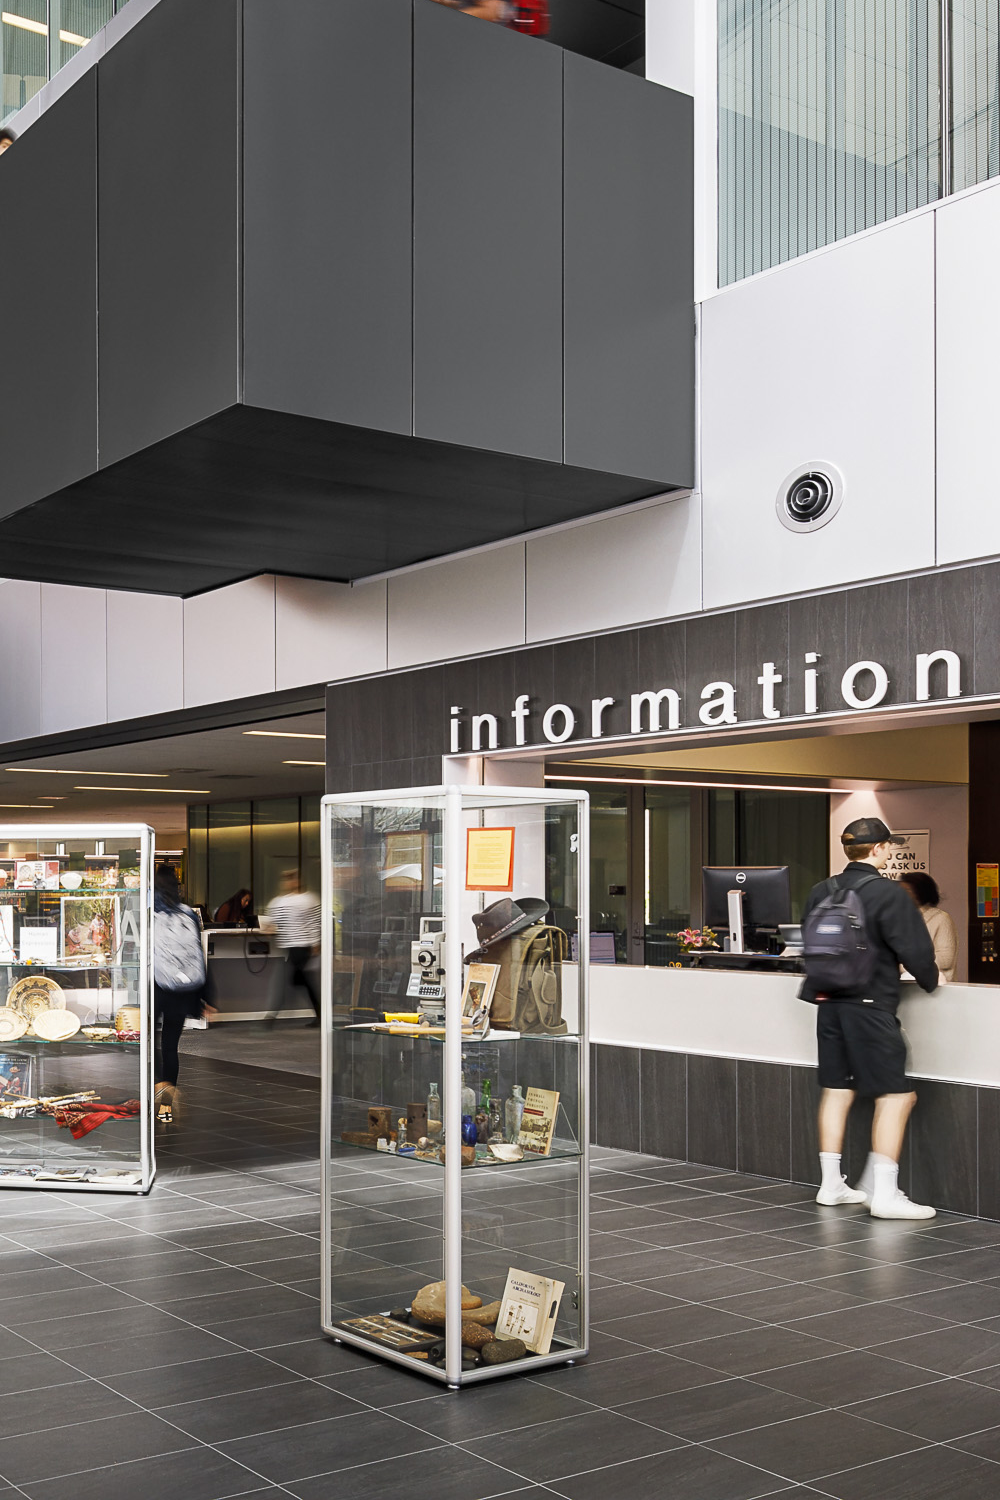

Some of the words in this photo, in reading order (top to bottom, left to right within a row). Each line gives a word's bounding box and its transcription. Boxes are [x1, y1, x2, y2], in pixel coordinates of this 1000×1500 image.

[450, 649, 961, 752] information
[895, 852, 916, 860] CAN
[891, 862, 910, 870] ASK
[913, 862, 926, 870] US
[510, 1279, 536, 1291] CALIFORNIA
